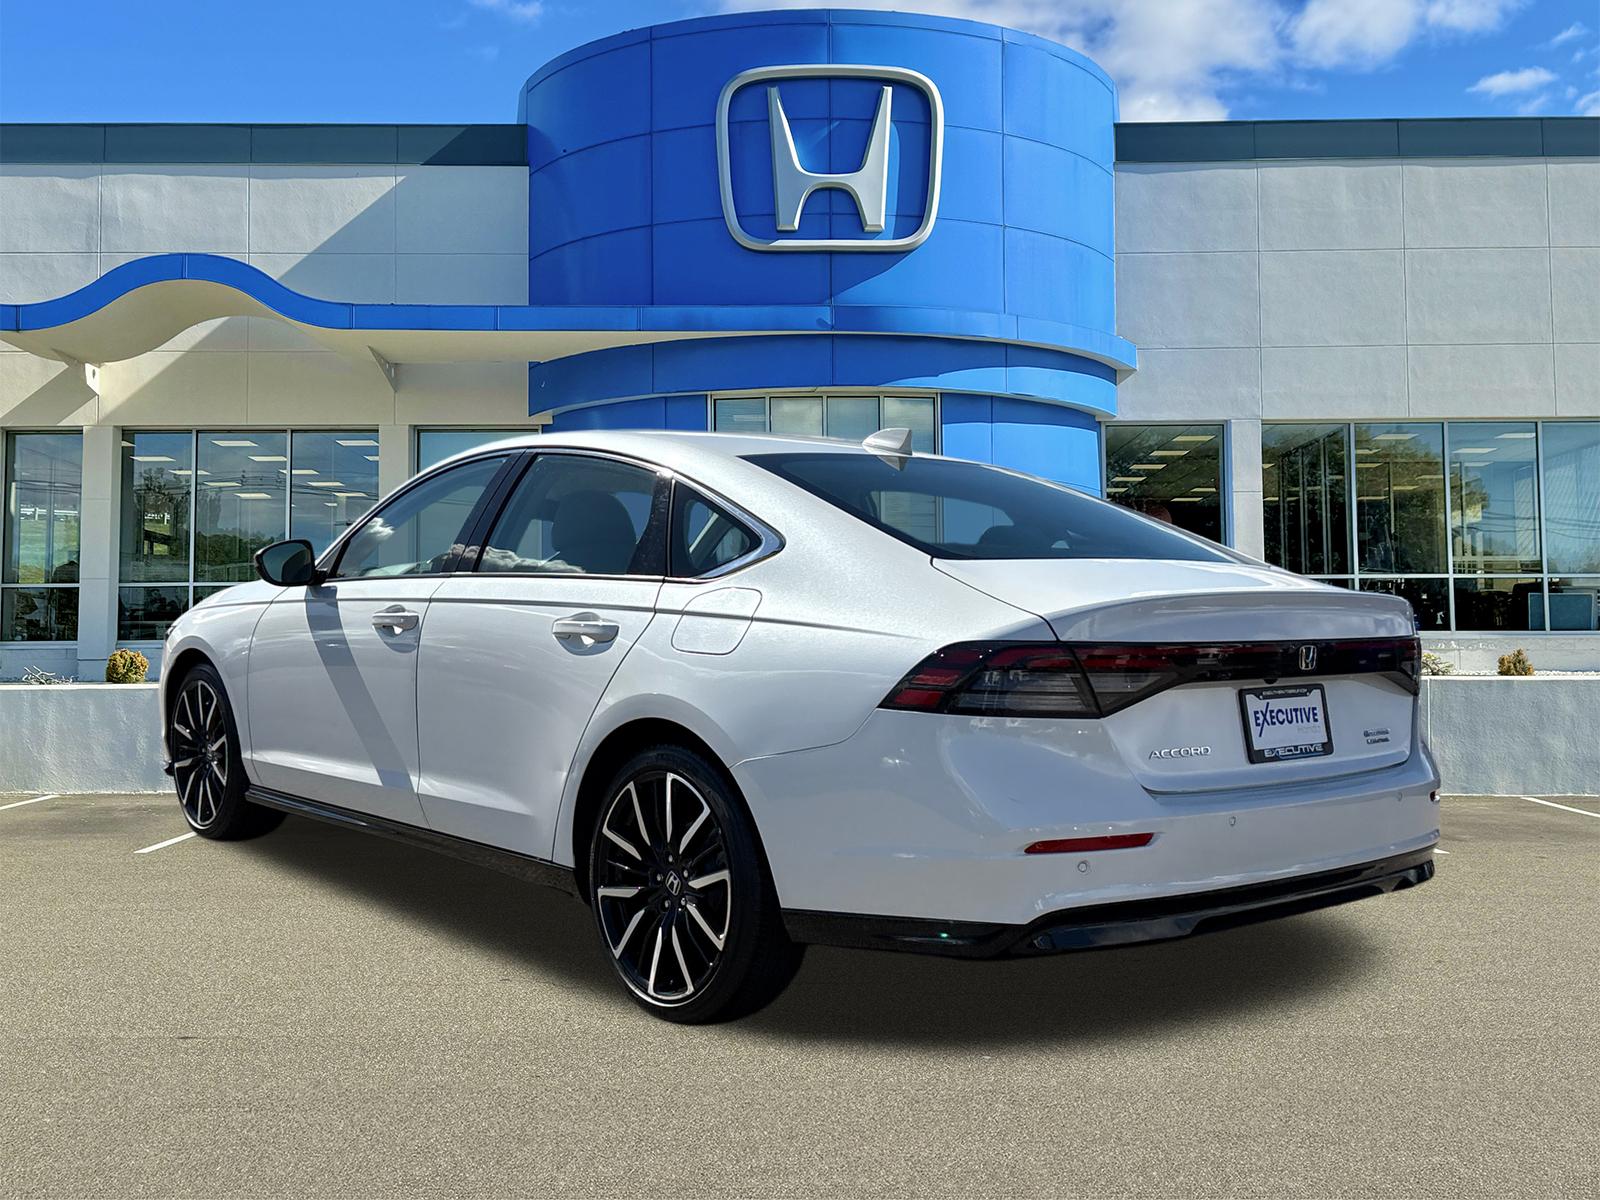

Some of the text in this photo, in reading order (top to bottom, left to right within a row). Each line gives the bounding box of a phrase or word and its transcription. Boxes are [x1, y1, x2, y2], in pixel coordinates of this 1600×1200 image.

[1253, 701, 1319, 738] EXECUTIVE
[1148, 746, 1212, 760] ACCORD
[1263, 743, 1325, 758] EXECUTIVE
